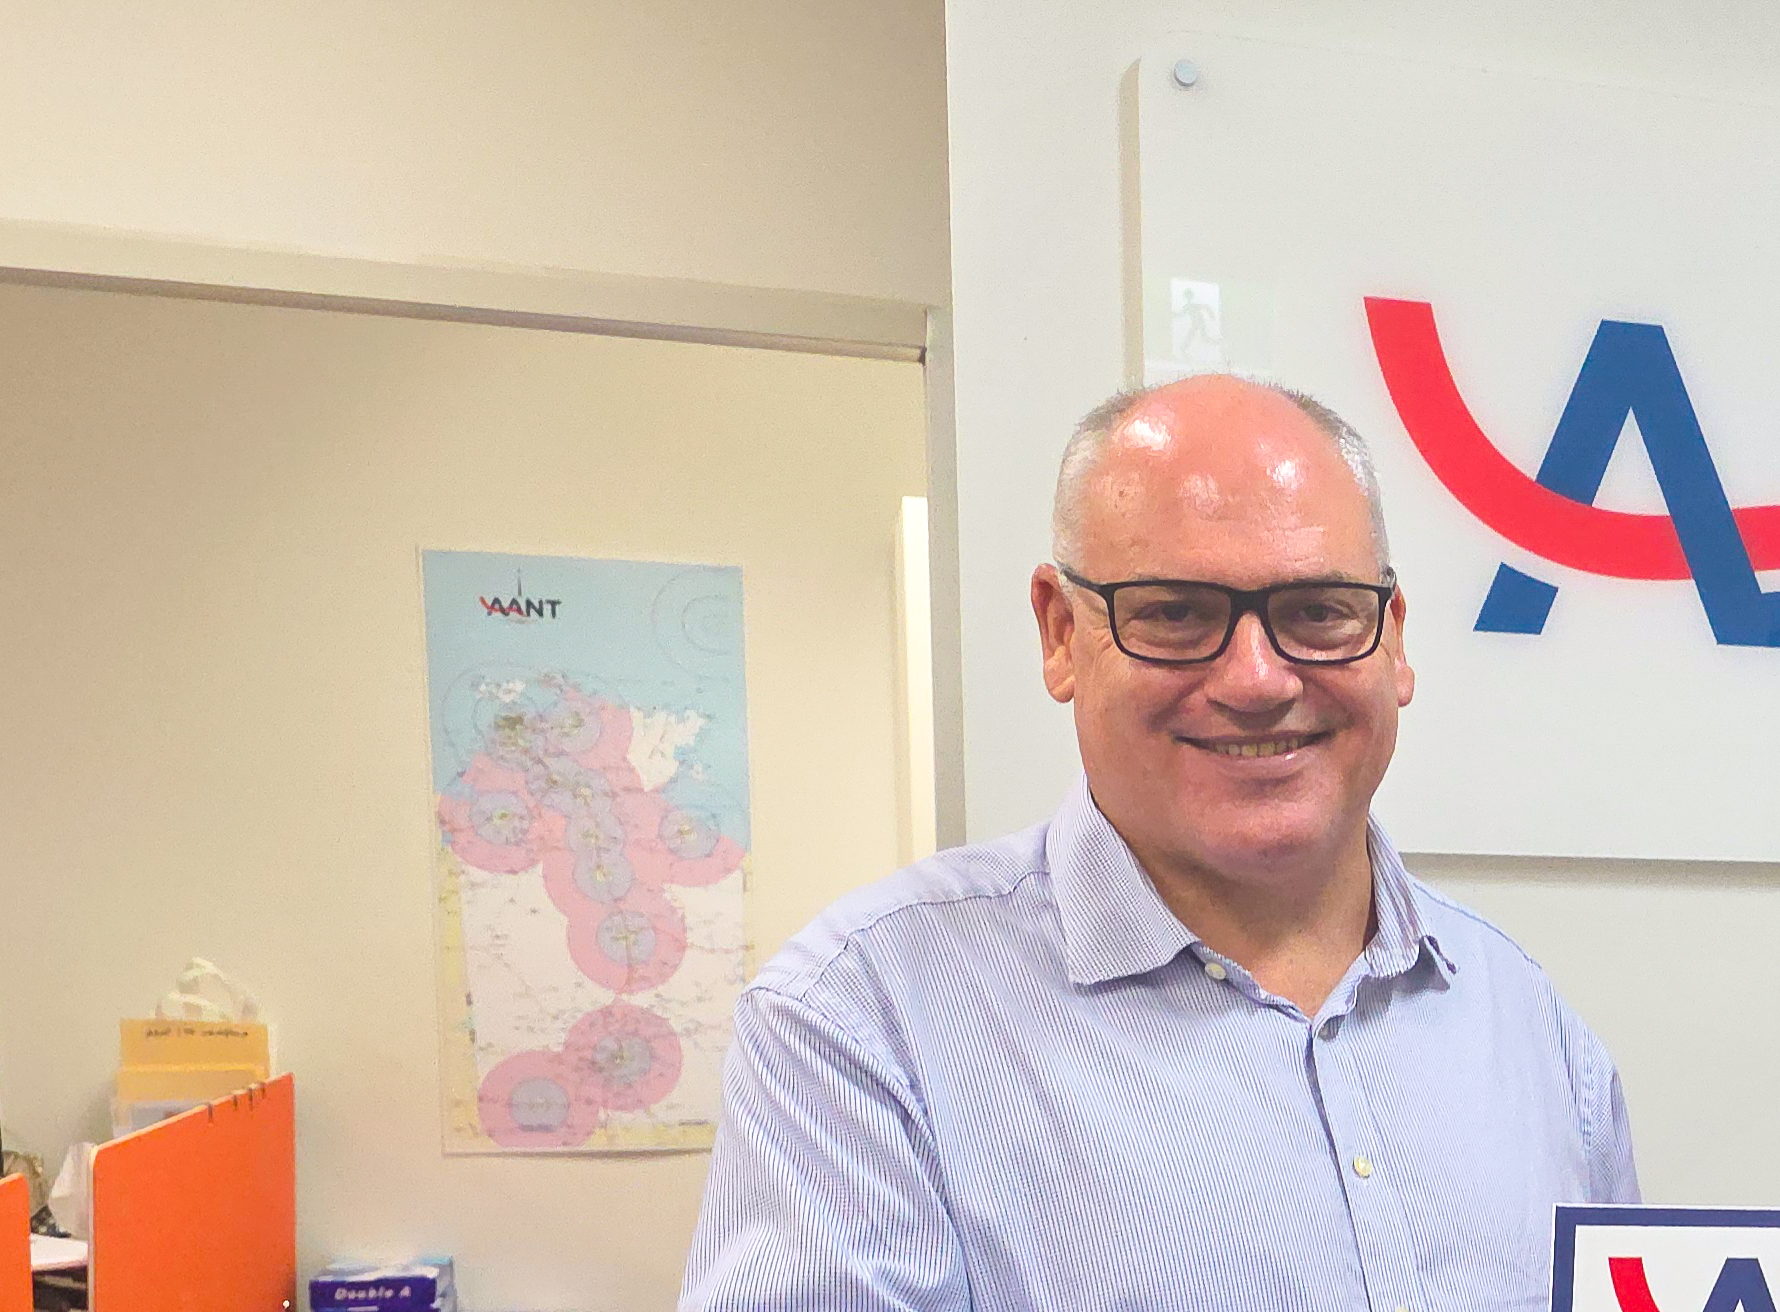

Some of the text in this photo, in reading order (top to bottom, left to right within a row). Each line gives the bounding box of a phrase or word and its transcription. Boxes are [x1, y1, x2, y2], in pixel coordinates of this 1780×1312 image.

[479, 595, 562, 619] AANT
[334, 1285, 412, 1300] Double A
